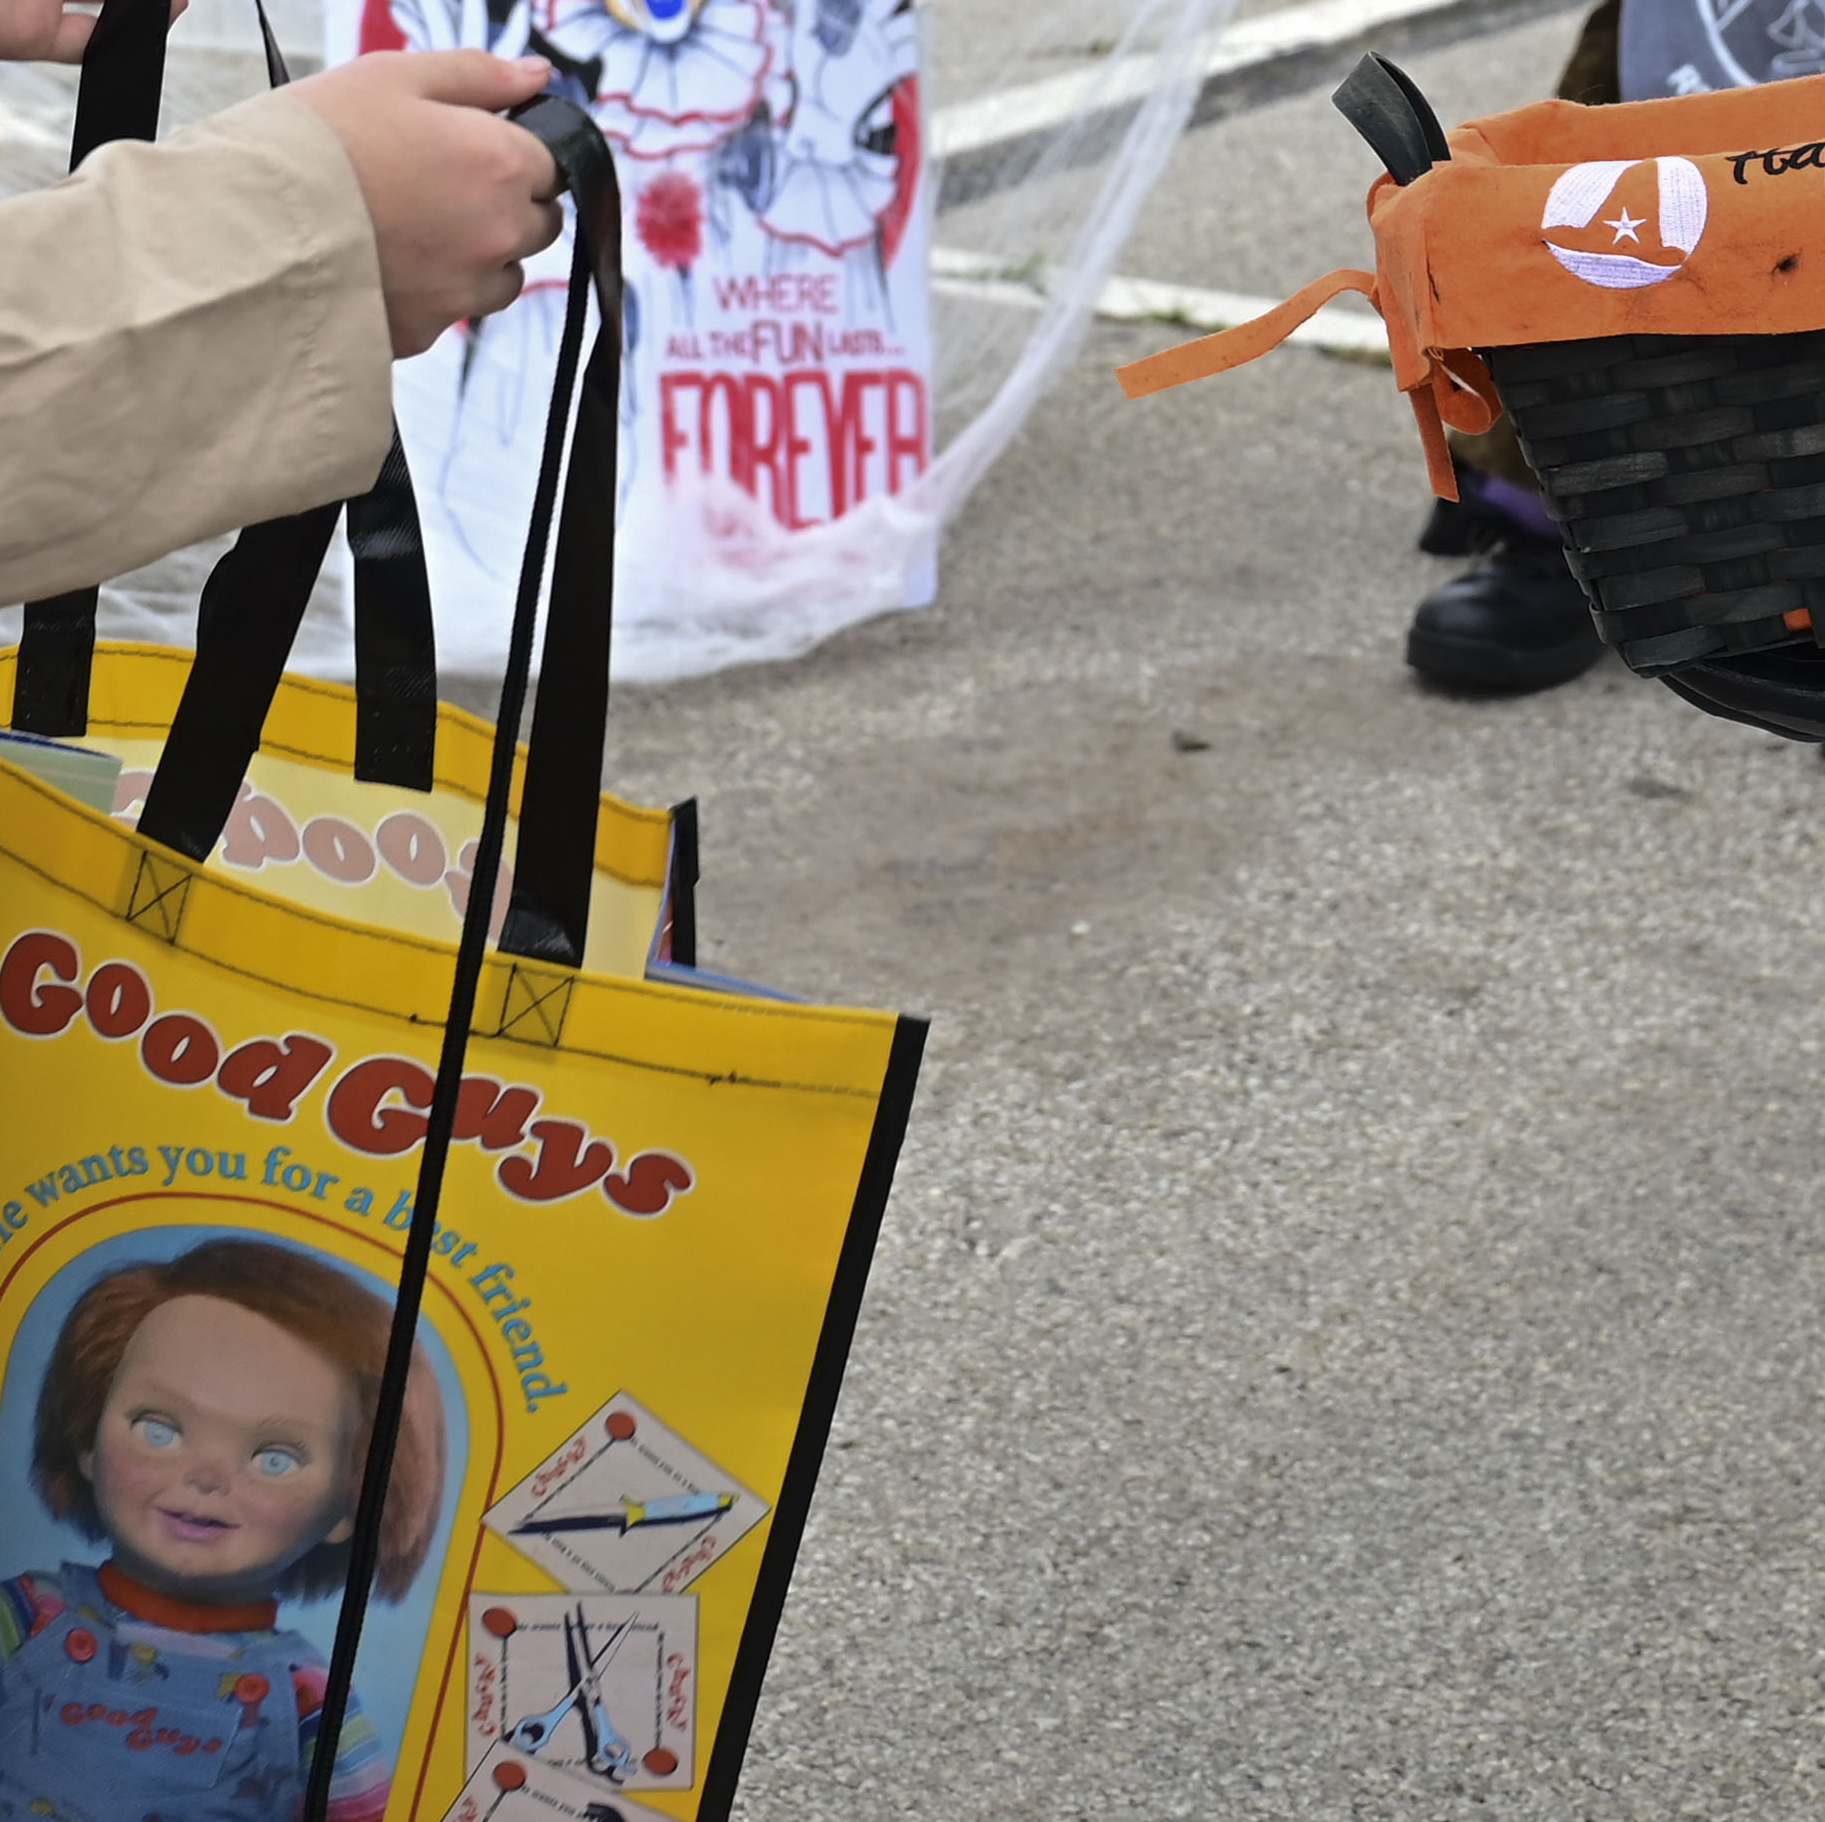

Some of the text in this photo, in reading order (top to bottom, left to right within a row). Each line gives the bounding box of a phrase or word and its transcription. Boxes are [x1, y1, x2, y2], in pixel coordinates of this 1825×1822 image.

[714, 274, 840, 314] WHERE
[751, 319, 824, 365] FUN
[659, 367, 929, 533] FOREVER
[324, 1052, 696, 1218] Guys
[24, 1144, 149, 1207] wants
[158, 1144, 246, 1185] you
[261, 1145, 339, 1200] for
[344, 1186, 374, 1216] a
[383, 1190, 478, 1268] bst
[469, 1262, 569, 1413] friend.
[61, 1702, 159, 1729] Good
[126, 1726, 223, 1757] Guys
